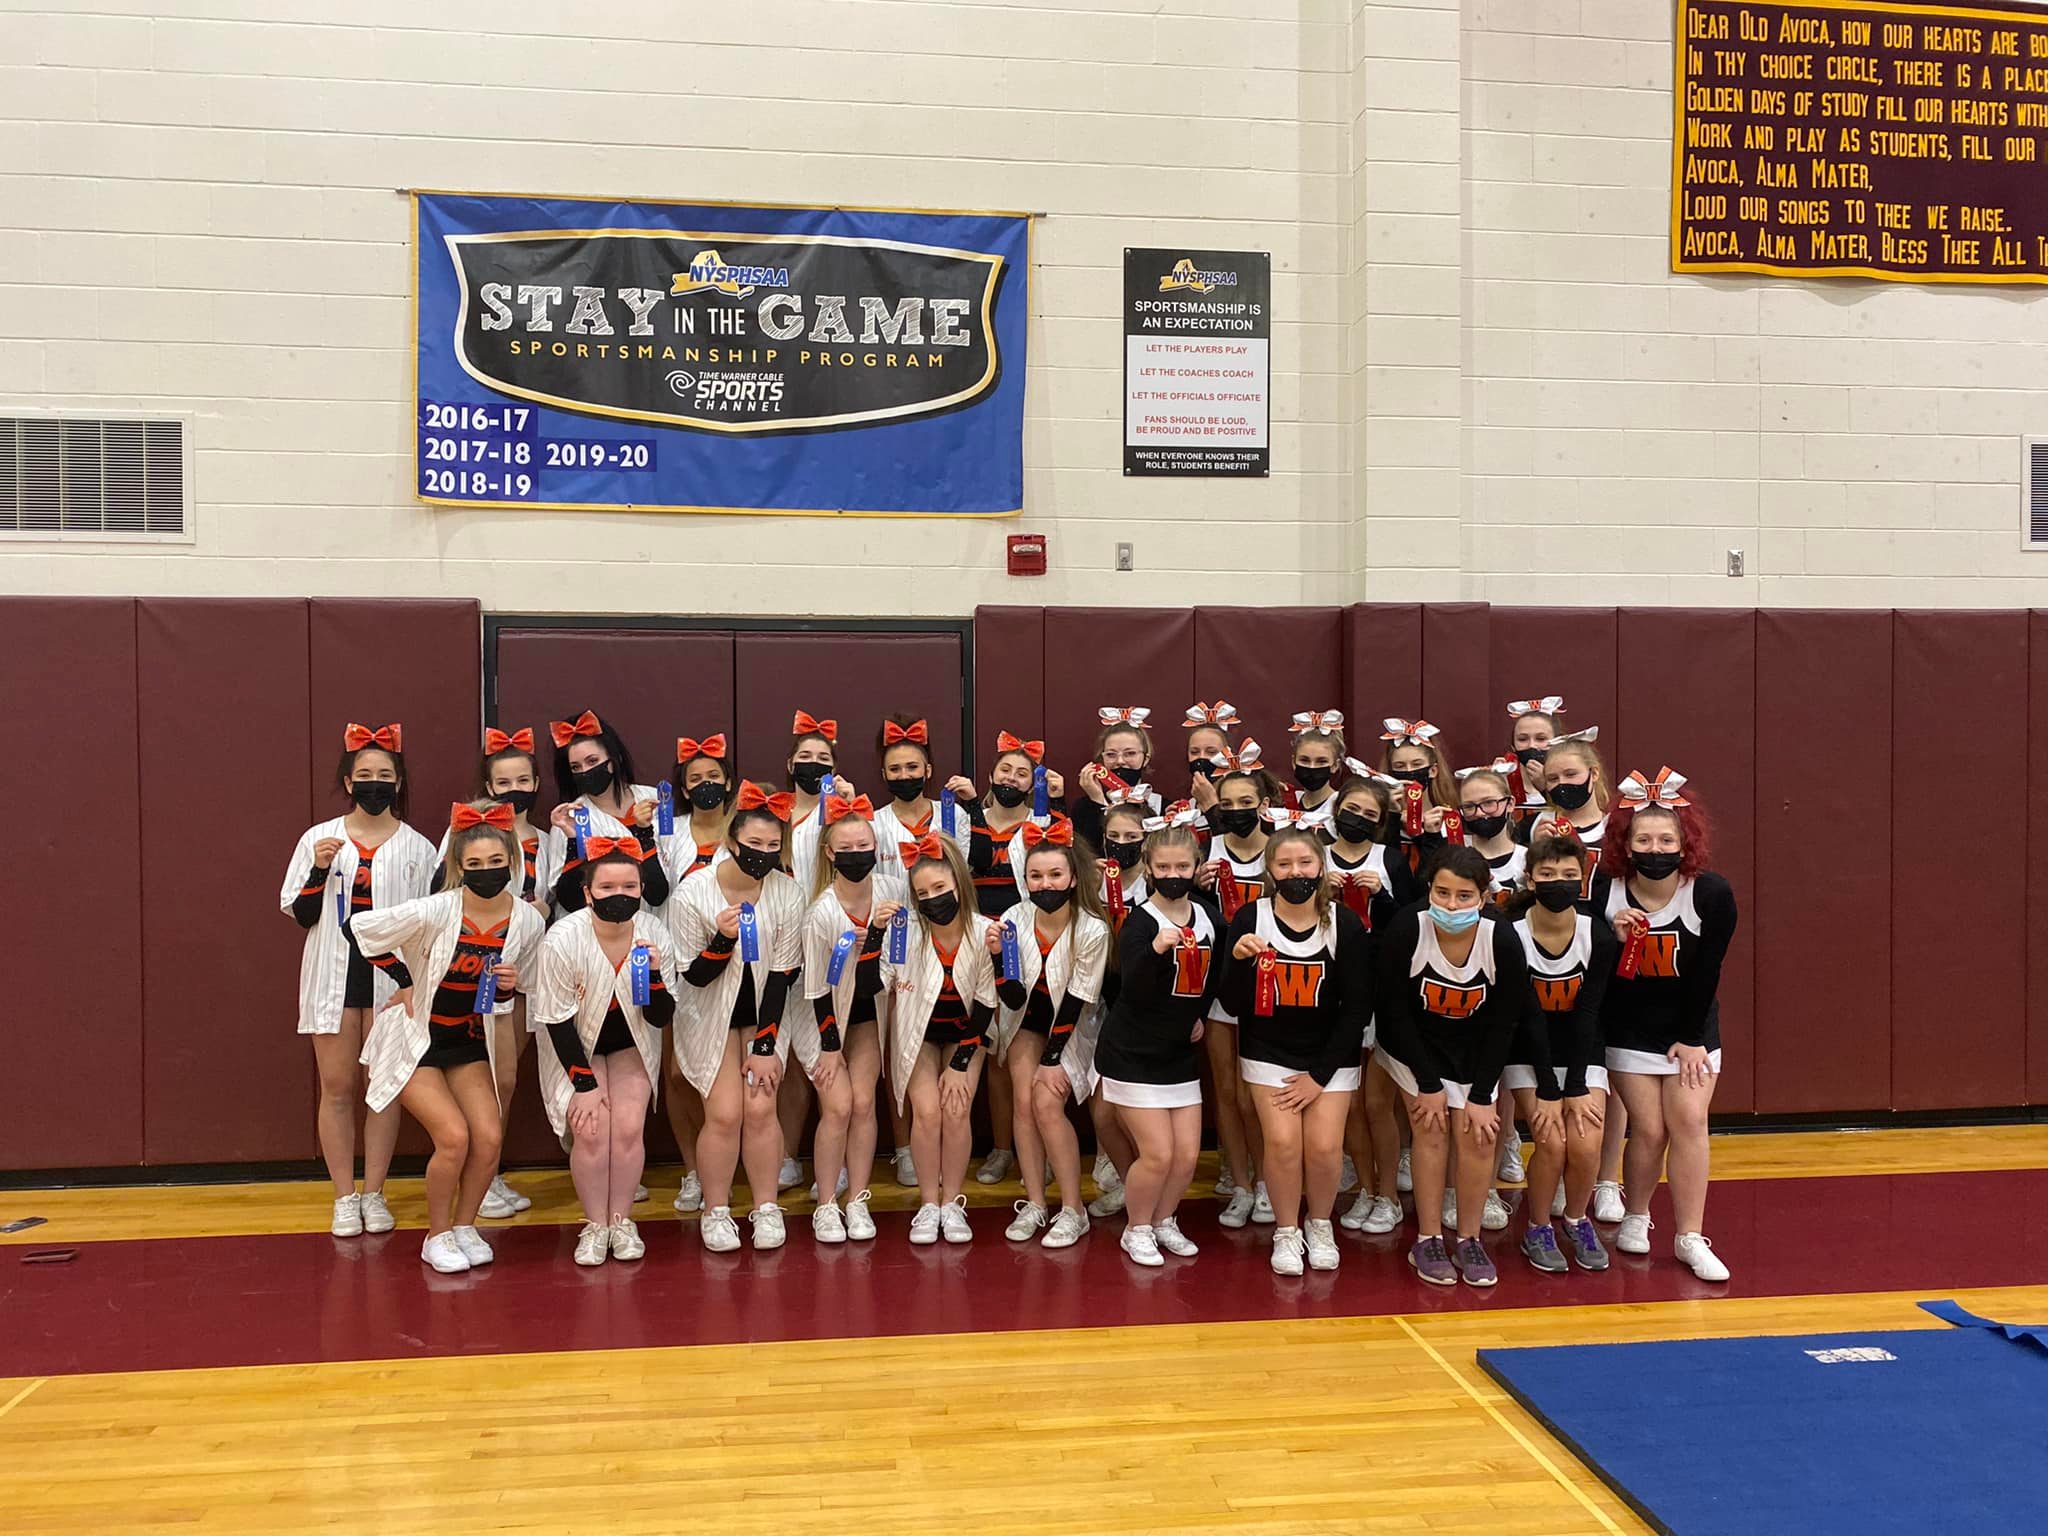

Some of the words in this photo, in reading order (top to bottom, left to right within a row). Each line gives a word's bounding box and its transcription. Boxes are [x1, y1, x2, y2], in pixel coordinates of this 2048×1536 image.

[689, 265, 788, 287] NYSPHSAA
[1172, 271, 1237, 285] NYSPHSAA
[480, 282, 665, 336] STAY
[674, 307, 695, 336] IN
[707, 308, 746, 336] THE
[757, 294, 971, 346] GAME
[1135, 301, 1246, 315] SPORTSMANSHIP
[1250, 304, 1261, 315] IS
[1143, 317, 1162, 328] AN
[1165, 318, 1253, 330] EXPECTATION
[510, 340, 779, 365] SPORTSMANSHIP
[801, 351, 945, 368] PROGRAM
[1165, 345, 1181, 353] THE
[1184, 345, 1223, 354] PLAYERS
[758, 373, 784, 381] CABLE
[1140, 368, 1156, 376] LET
[1178, 369, 1220, 377] COACHES
[1222, 370, 1254, 378] COACH
[696, 381, 784, 400] SPORTS
[1150, 392, 1167, 400] THE
[1170, 393, 1214, 401] OFFICIALS
[694, 400, 780, 411] CHANNEL
[425, 405, 529, 432] 2016-17
[1145, 416, 1167, 424] FANS
[1170, 416, 1205, 424] SHOULD
[1222, 417, 1248, 426] LOUD,
[1136, 426, 1147, 434] BE
[1183, 427, 1201, 435] AND
[1218, 428, 1256, 436] POSITIVE
[425, 439, 531, 465] 2017-18
[546, 444, 649, 468] 2019-20
[1136, 452, 1159, 460] WHEN
[1161, 452, 1203, 460] EVERYONE
[1205, 453, 1234, 461] KNOWS
[1237, 453, 1259, 461] THEIR
[1146, 462, 1169, 470] ROLE,
[1171, 462, 1212, 470] STUDENTS
[1215, 463, 1249, 471] BENEFIT!
[425, 470, 532, 497] 2018-19
[1645, 783, 1662, 801] W
[894, 930, 902, 961] PLACE
[1007, 945, 1015, 976] PLACE
[1625, 940, 1639, 972] PLACE
[1273, 961, 1323, 1007] W
[1533, 974, 1583, 1012] W
[1422, 980, 1484, 1018] W
